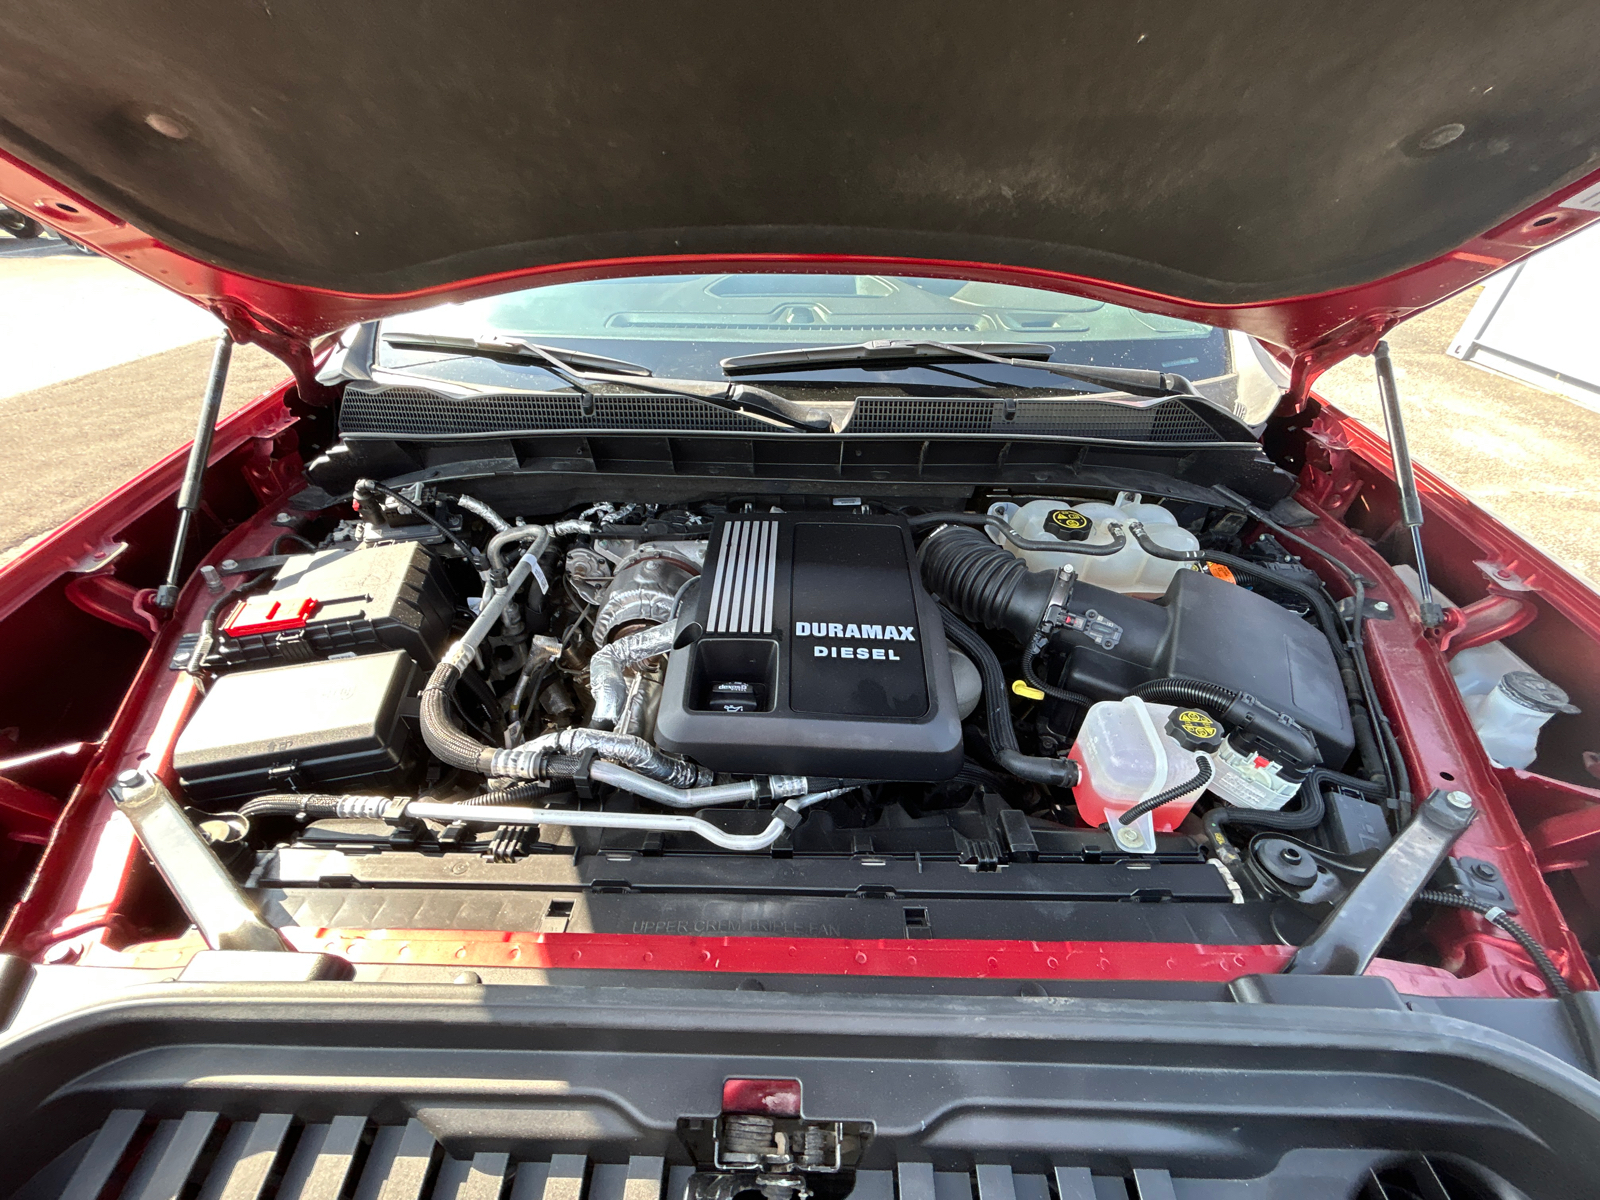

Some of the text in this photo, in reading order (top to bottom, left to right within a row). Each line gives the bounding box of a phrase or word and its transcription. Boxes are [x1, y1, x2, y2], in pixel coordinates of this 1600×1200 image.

[795, 621, 916, 641] DURAMAX
[814, 646, 900, 661] DIESEL
[632, 920, 689, 934] UPPER
[809, 922, 840, 936] FAN
